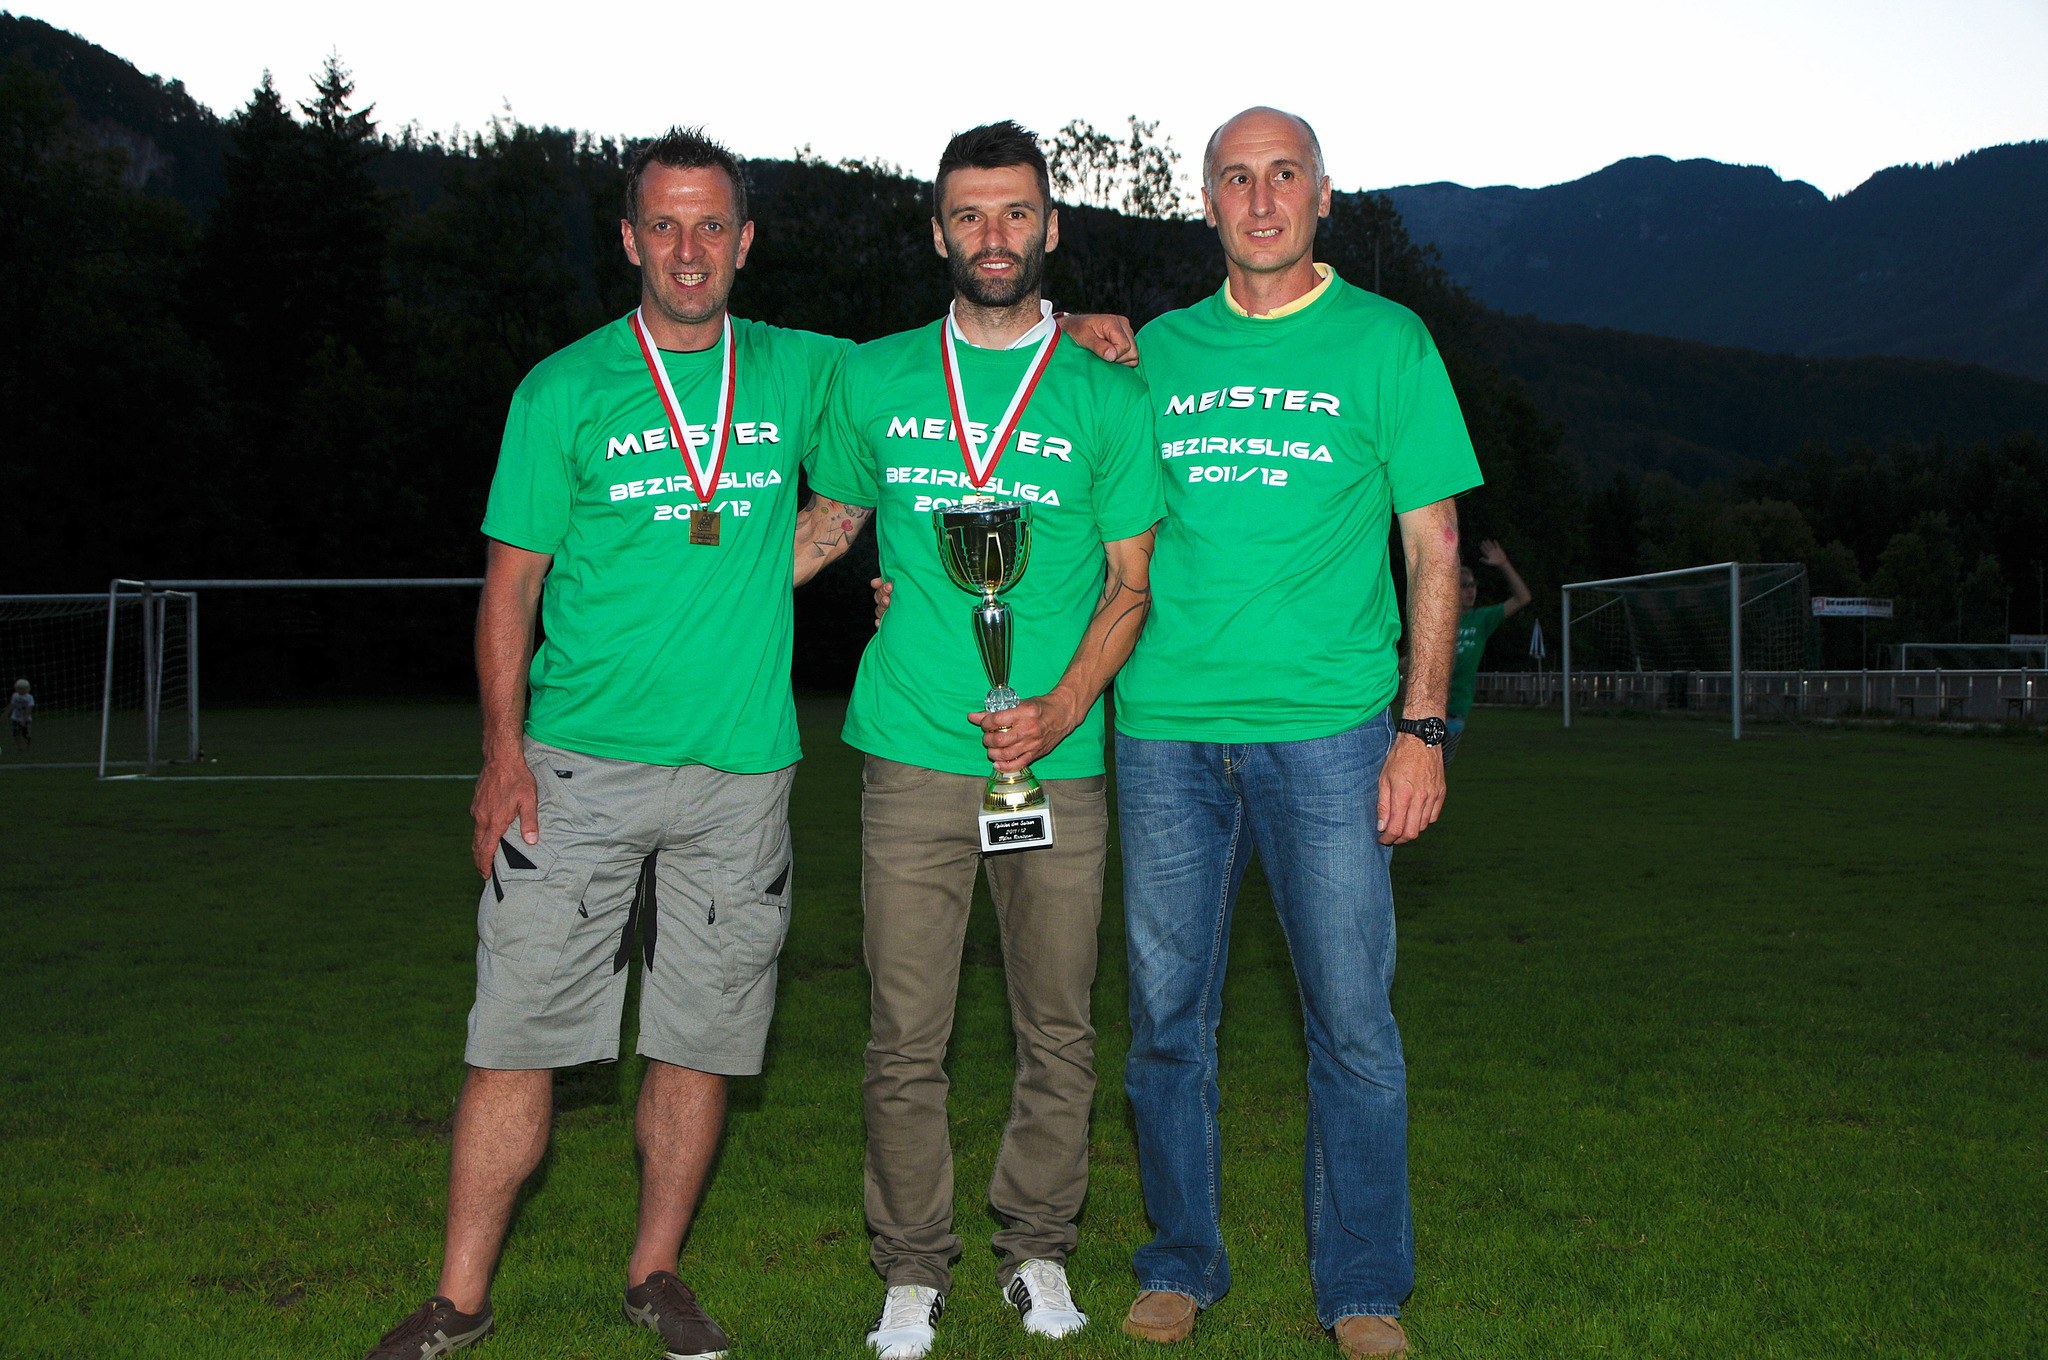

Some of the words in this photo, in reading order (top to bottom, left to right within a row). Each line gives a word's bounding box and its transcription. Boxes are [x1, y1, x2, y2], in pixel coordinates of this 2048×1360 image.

[1163, 386, 1341, 417] MEISTER
[1161, 436, 1334, 463] BEZIRKSLIGA
[609, 469, 782, 502] BEZIRSLIGA
[1188, 465, 1289, 487] 2011/12
[653, 500, 752, 521] 20/12
